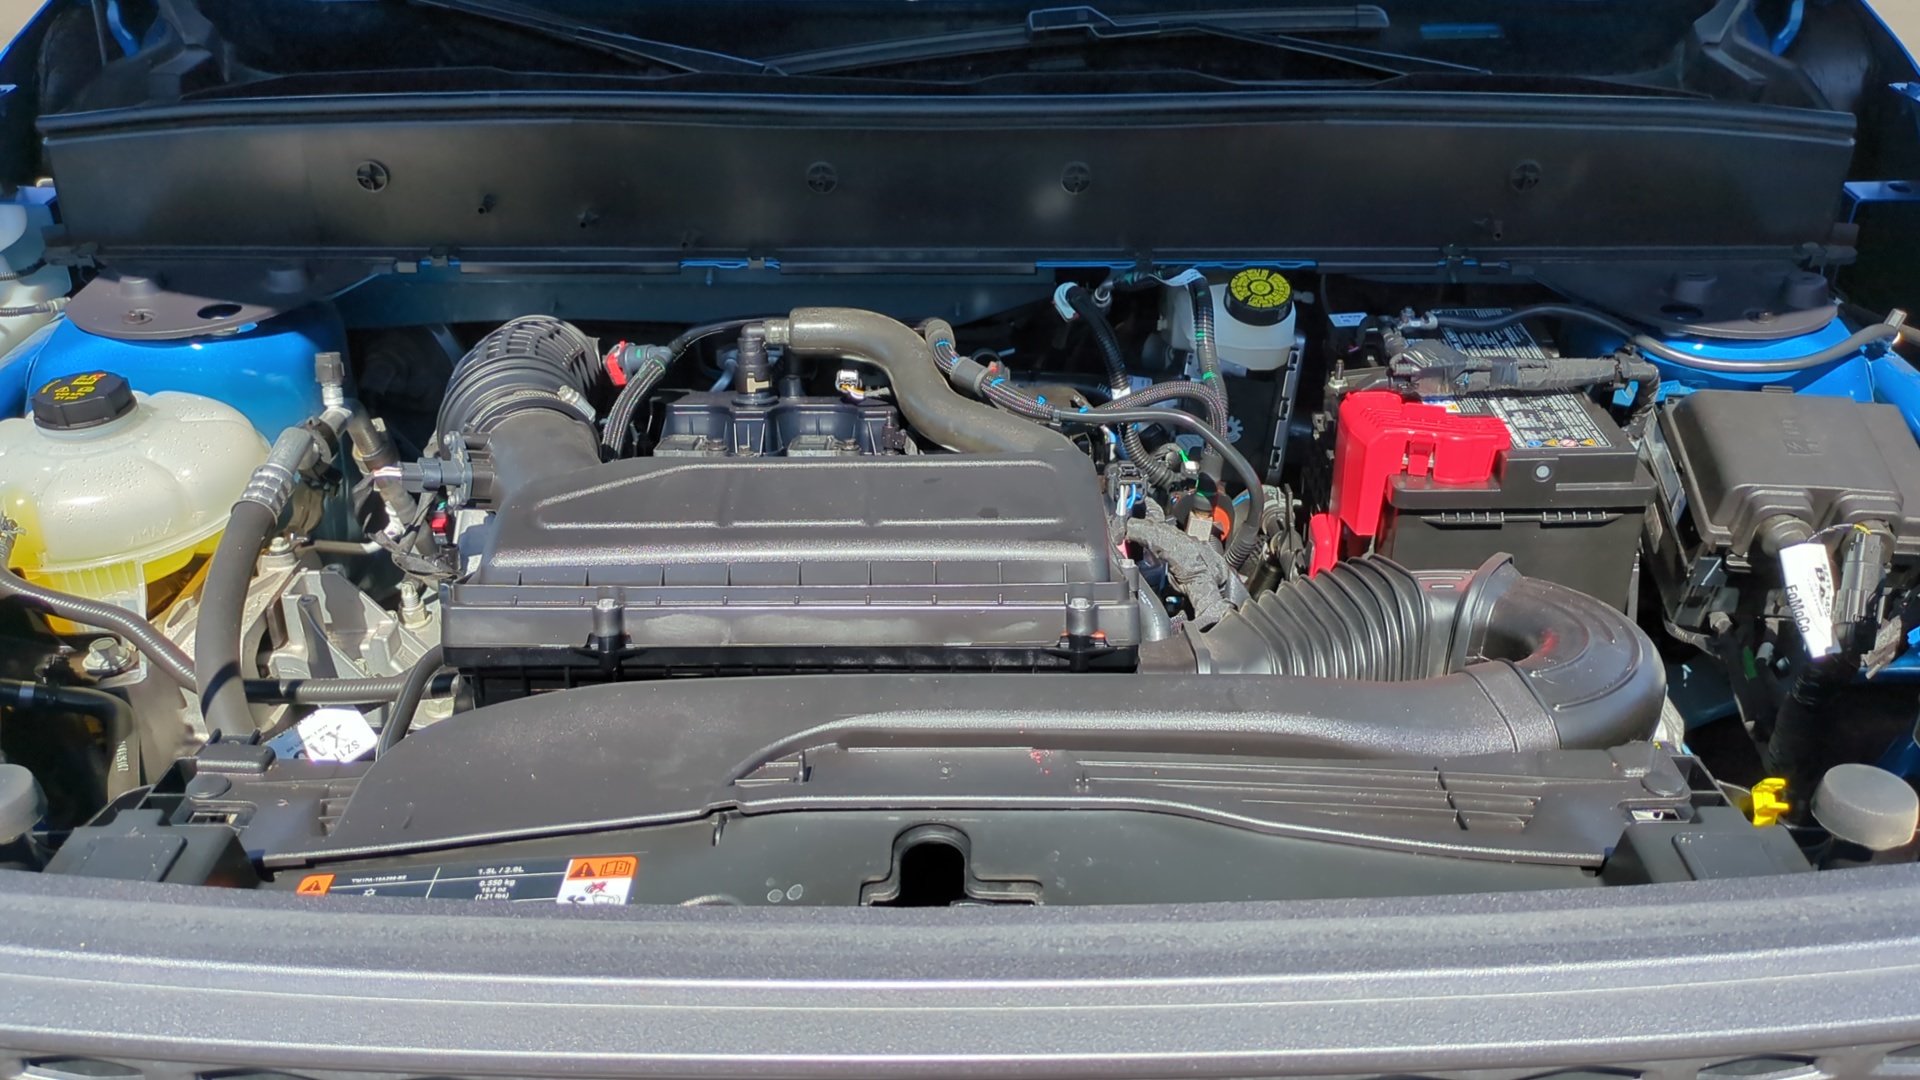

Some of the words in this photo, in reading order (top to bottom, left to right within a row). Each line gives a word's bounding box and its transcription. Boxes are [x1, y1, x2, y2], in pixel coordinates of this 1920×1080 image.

[1786, 584, 1810, 634] FoMoCo
[479, 879, 505, 887] 0.550
[505, 879, 516, 887] kg
